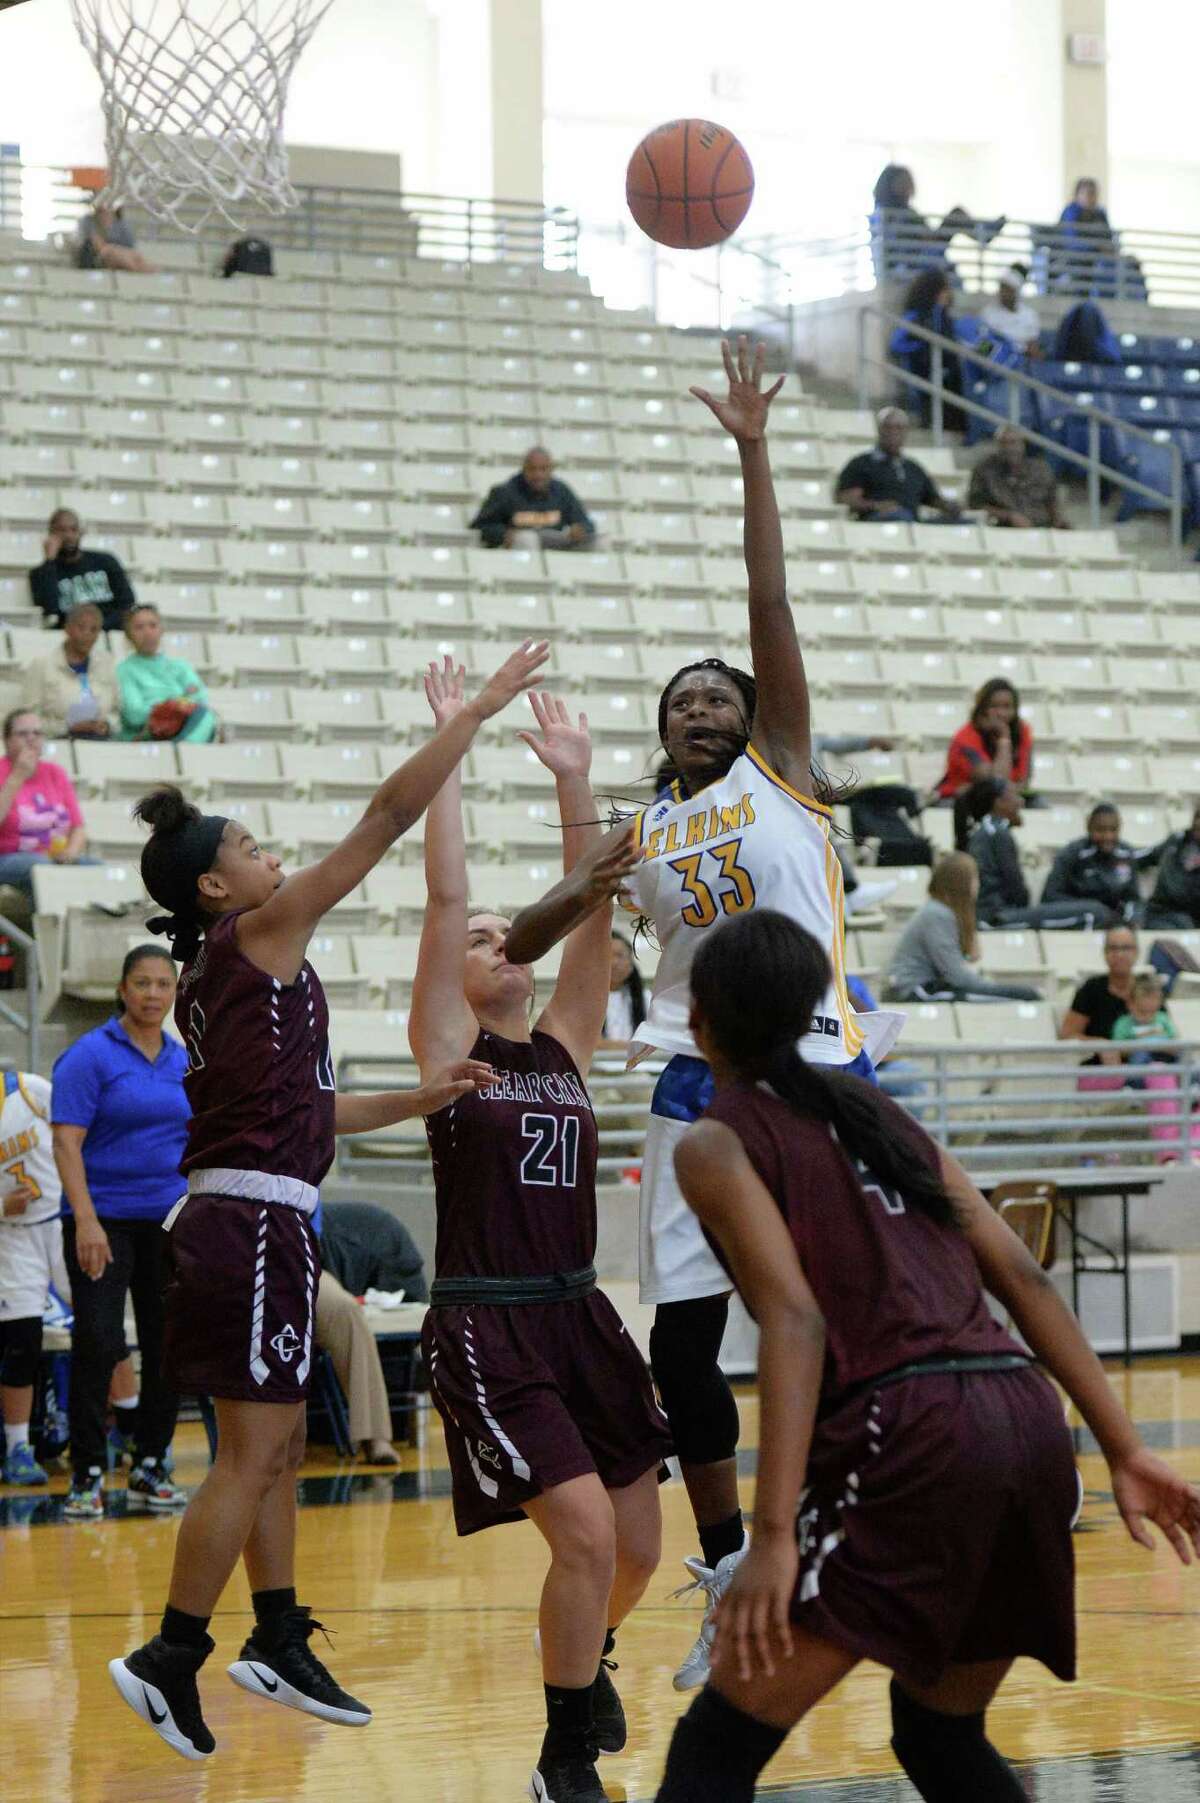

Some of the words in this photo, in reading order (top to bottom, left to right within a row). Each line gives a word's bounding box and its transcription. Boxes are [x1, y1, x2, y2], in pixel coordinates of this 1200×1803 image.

[644, 793, 756, 860] ELKINS
[667, 837, 756, 928] 33
[520, 1112, 580, 1188] 21
